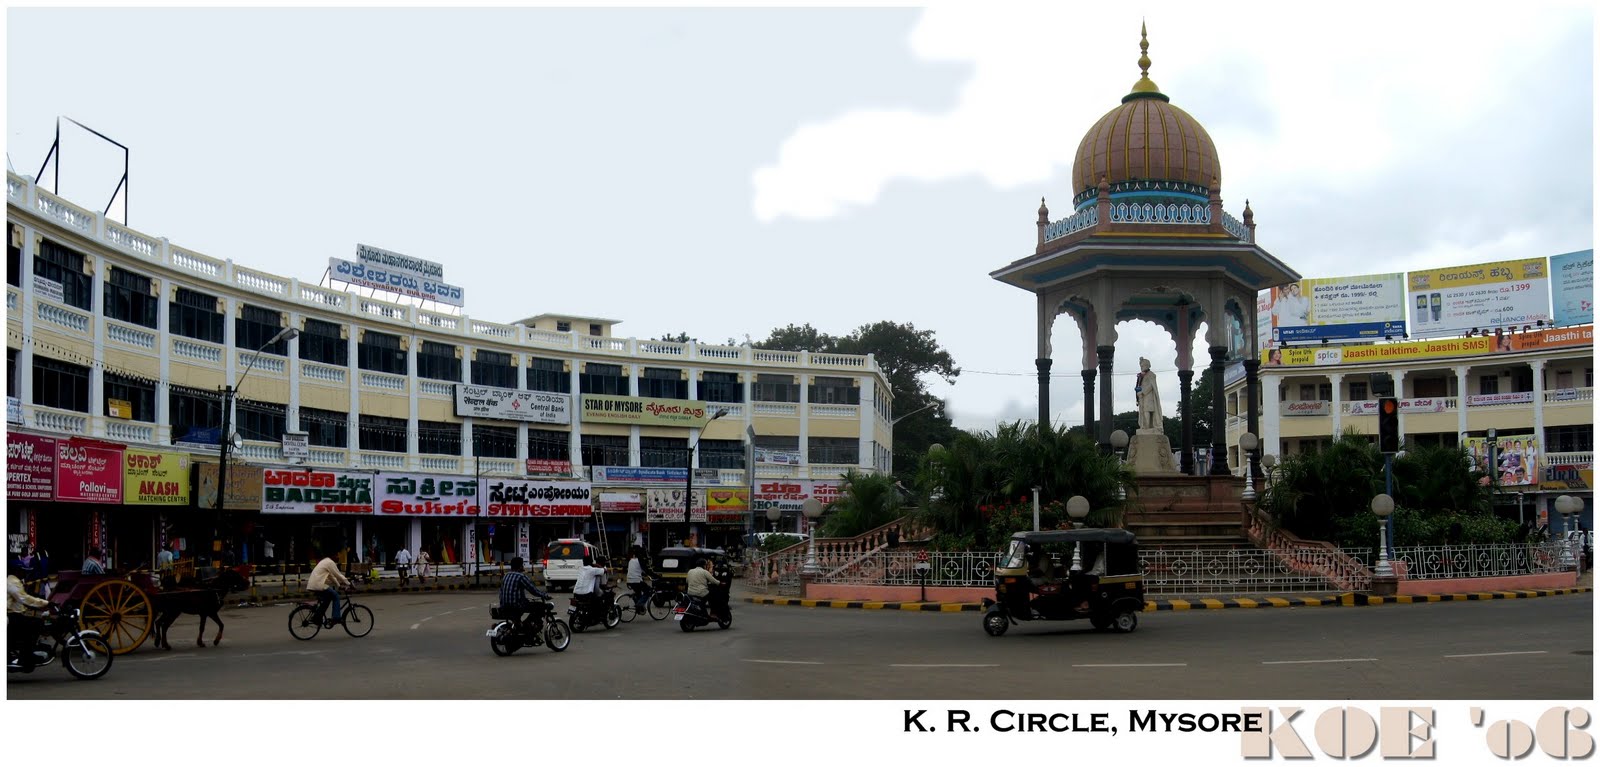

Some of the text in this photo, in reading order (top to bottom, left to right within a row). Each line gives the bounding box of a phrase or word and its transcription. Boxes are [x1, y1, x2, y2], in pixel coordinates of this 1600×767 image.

[1543, 330, 1580, 343] Jaasthi
[1318, 351, 1338, 359] spice
[1344, 340, 1488, 358] Jaasthi talktime. Jaasthi SMS!
[518, 393, 532, 402] ಆಫ್
[530, 403, 564, 413] Central Bank
[585, 399, 642, 412] STAR OF MYSORE
[646, 402, 681, 416] ಮೈಸೂರು
[683, 407, 704, 418] ಮಿತ್ರ
[60, 444, 87, 463] ಪಲ್ಲವಿ
[127, 454, 162, 469] ಆಕಾಶ್
[80, 480, 106, 493] Pallavi
[139, 480, 179, 495] AKASH
[265, 488, 372, 503] BADSHA
[488, 504, 592, 516] STATES EMPORIUM
